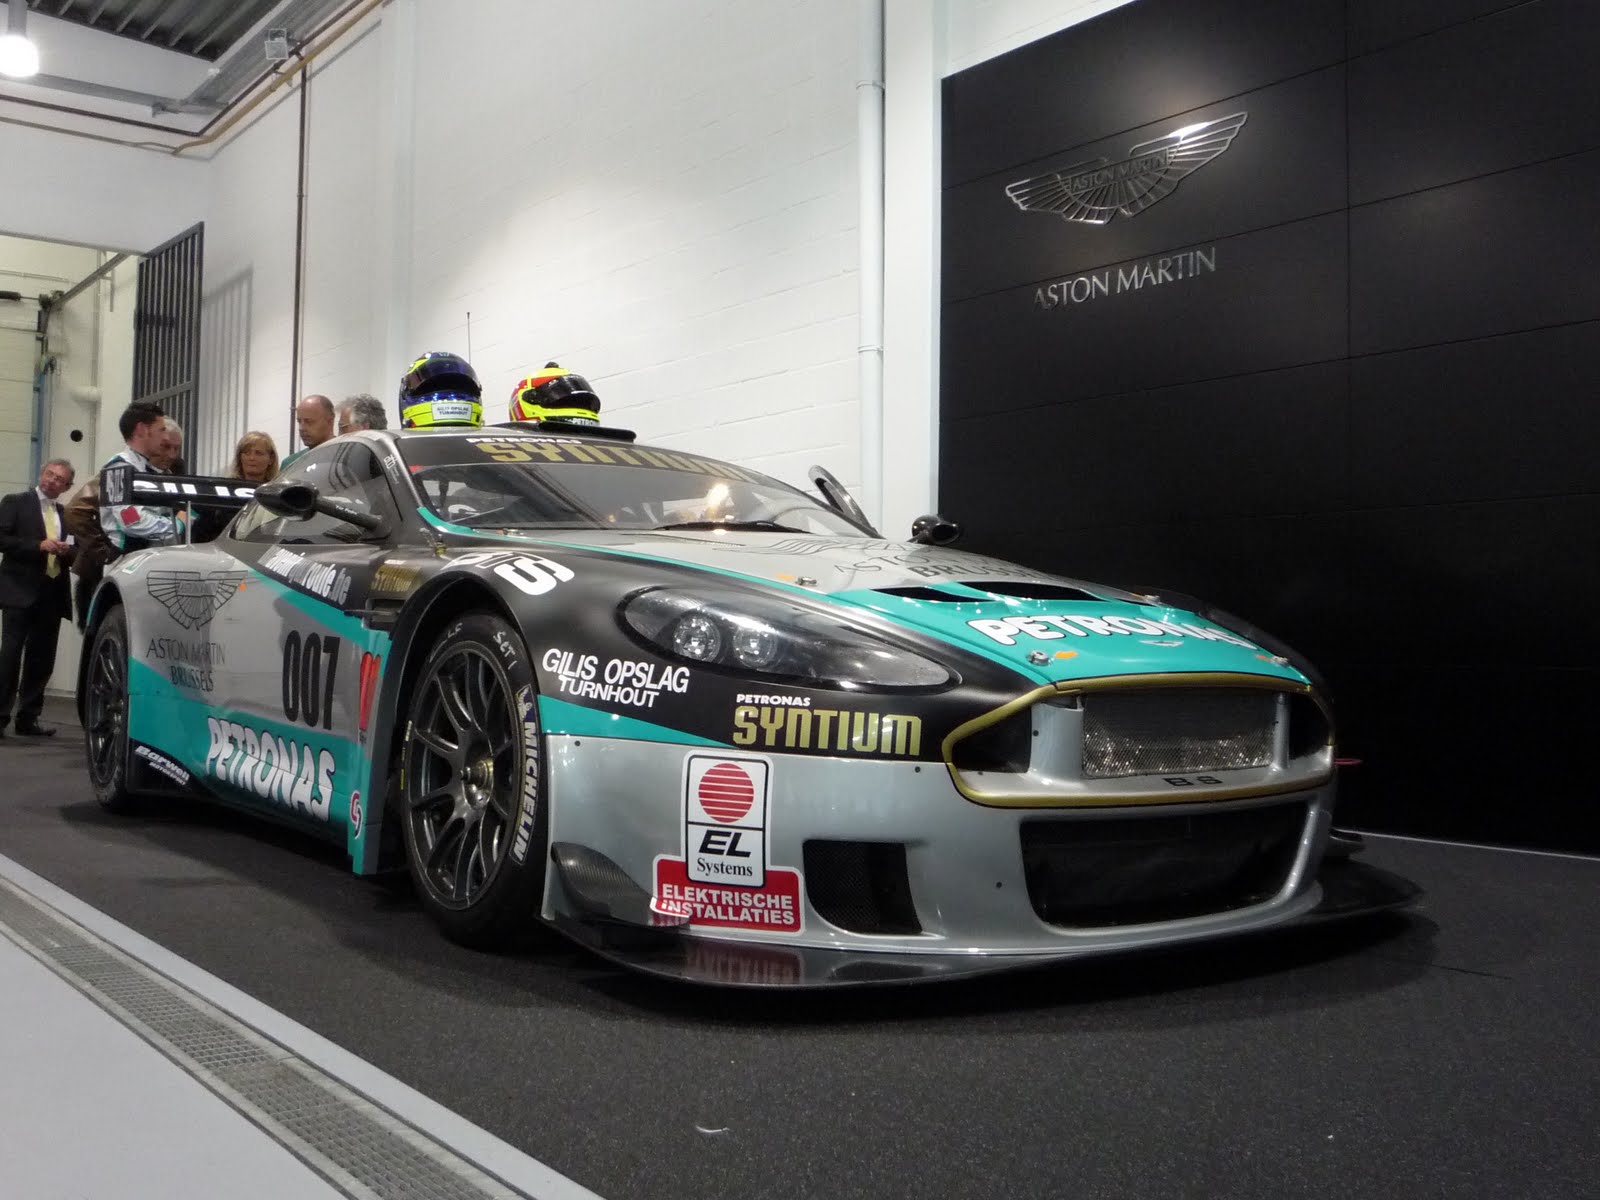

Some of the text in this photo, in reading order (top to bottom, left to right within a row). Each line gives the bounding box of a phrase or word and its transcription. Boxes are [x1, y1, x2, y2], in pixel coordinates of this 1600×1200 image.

[1033, 247, 1215, 309] ASTON MARTIN
[466, 437, 582, 445] PETRONAS
[475, 442, 760, 486] SYNTIUM
[966, 614, 1258, 650] PETRONAS
[146, 638, 189, 661] ASTON
[282, 629, 341, 731] 007
[542, 648, 691, 694] GILIS OPSLAG
[558, 675, 660, 708] TURNHOUT
[736, 693, 811, 707] PETRONAS
[732, 705, 922, 757] SYNTIUM
[205, 717, 336, 822] PETRONAS
[513, 721, 539, 862] MICHELIN
[698, 829, 752, 858] EL
[696, 858, 753, 877] Systems
[661, 900, 795, 926] INSTALLATIES
[662, 883, 793, 910] ELEKTRISCHE
